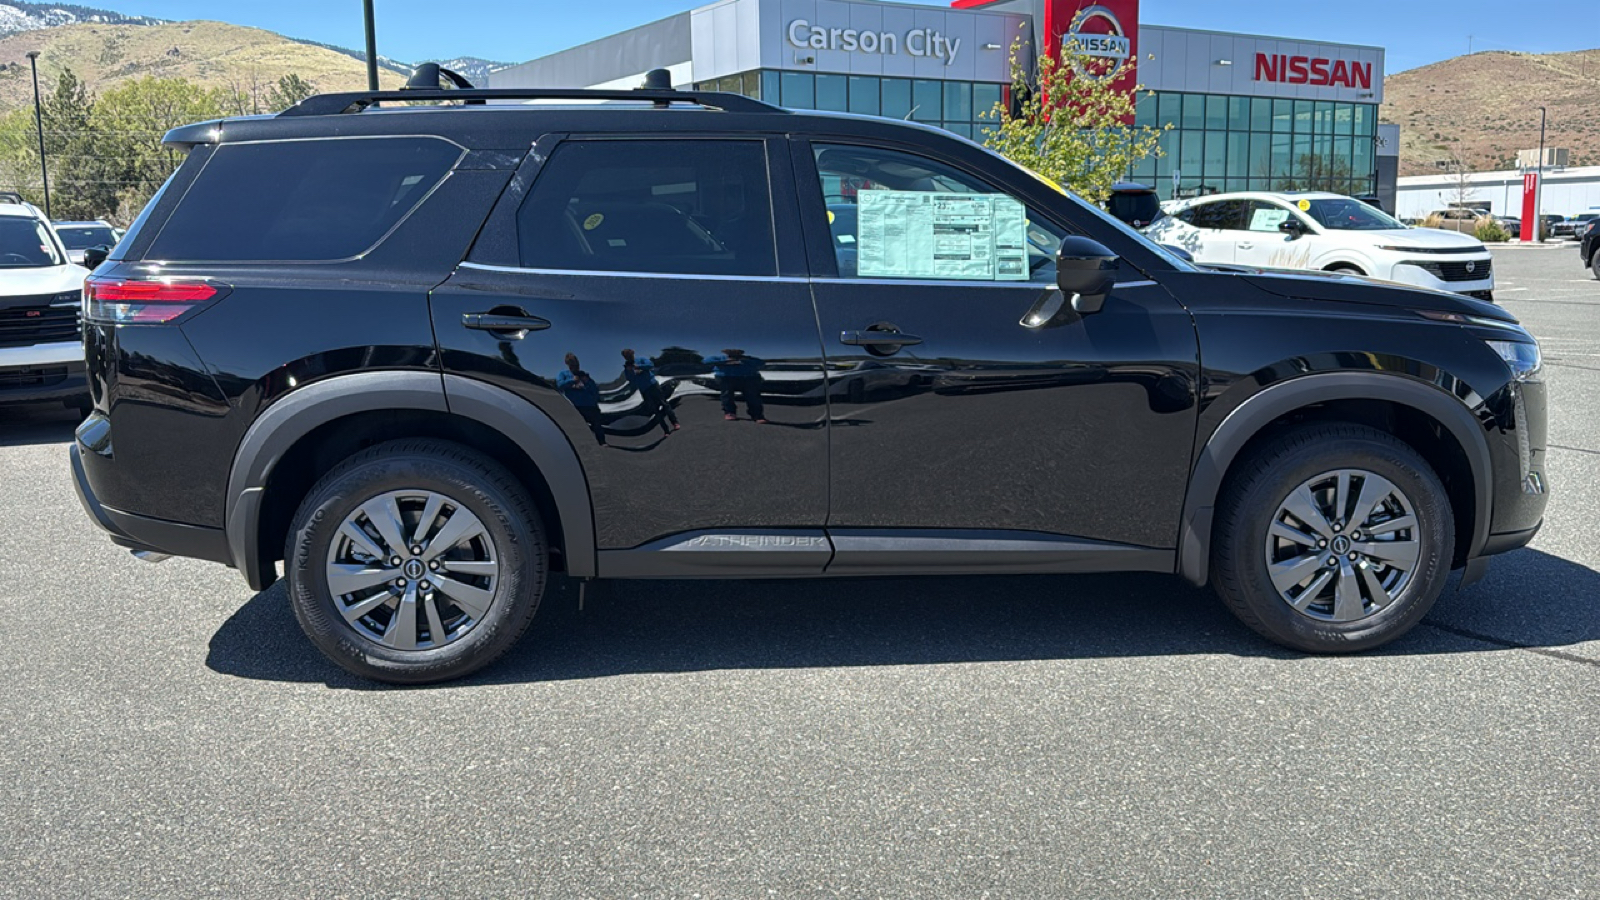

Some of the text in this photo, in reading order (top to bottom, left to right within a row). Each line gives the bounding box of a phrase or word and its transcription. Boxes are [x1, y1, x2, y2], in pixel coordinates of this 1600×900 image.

[788, 19, 961, 66] Carson City
[1072, 38, 1127, 54] NISSAN
[1254, 52, 1372, 90] NISSAN
[297, 508, 326, 571] KUMHO
[687, 534, 826, 547] PATHFINDER
